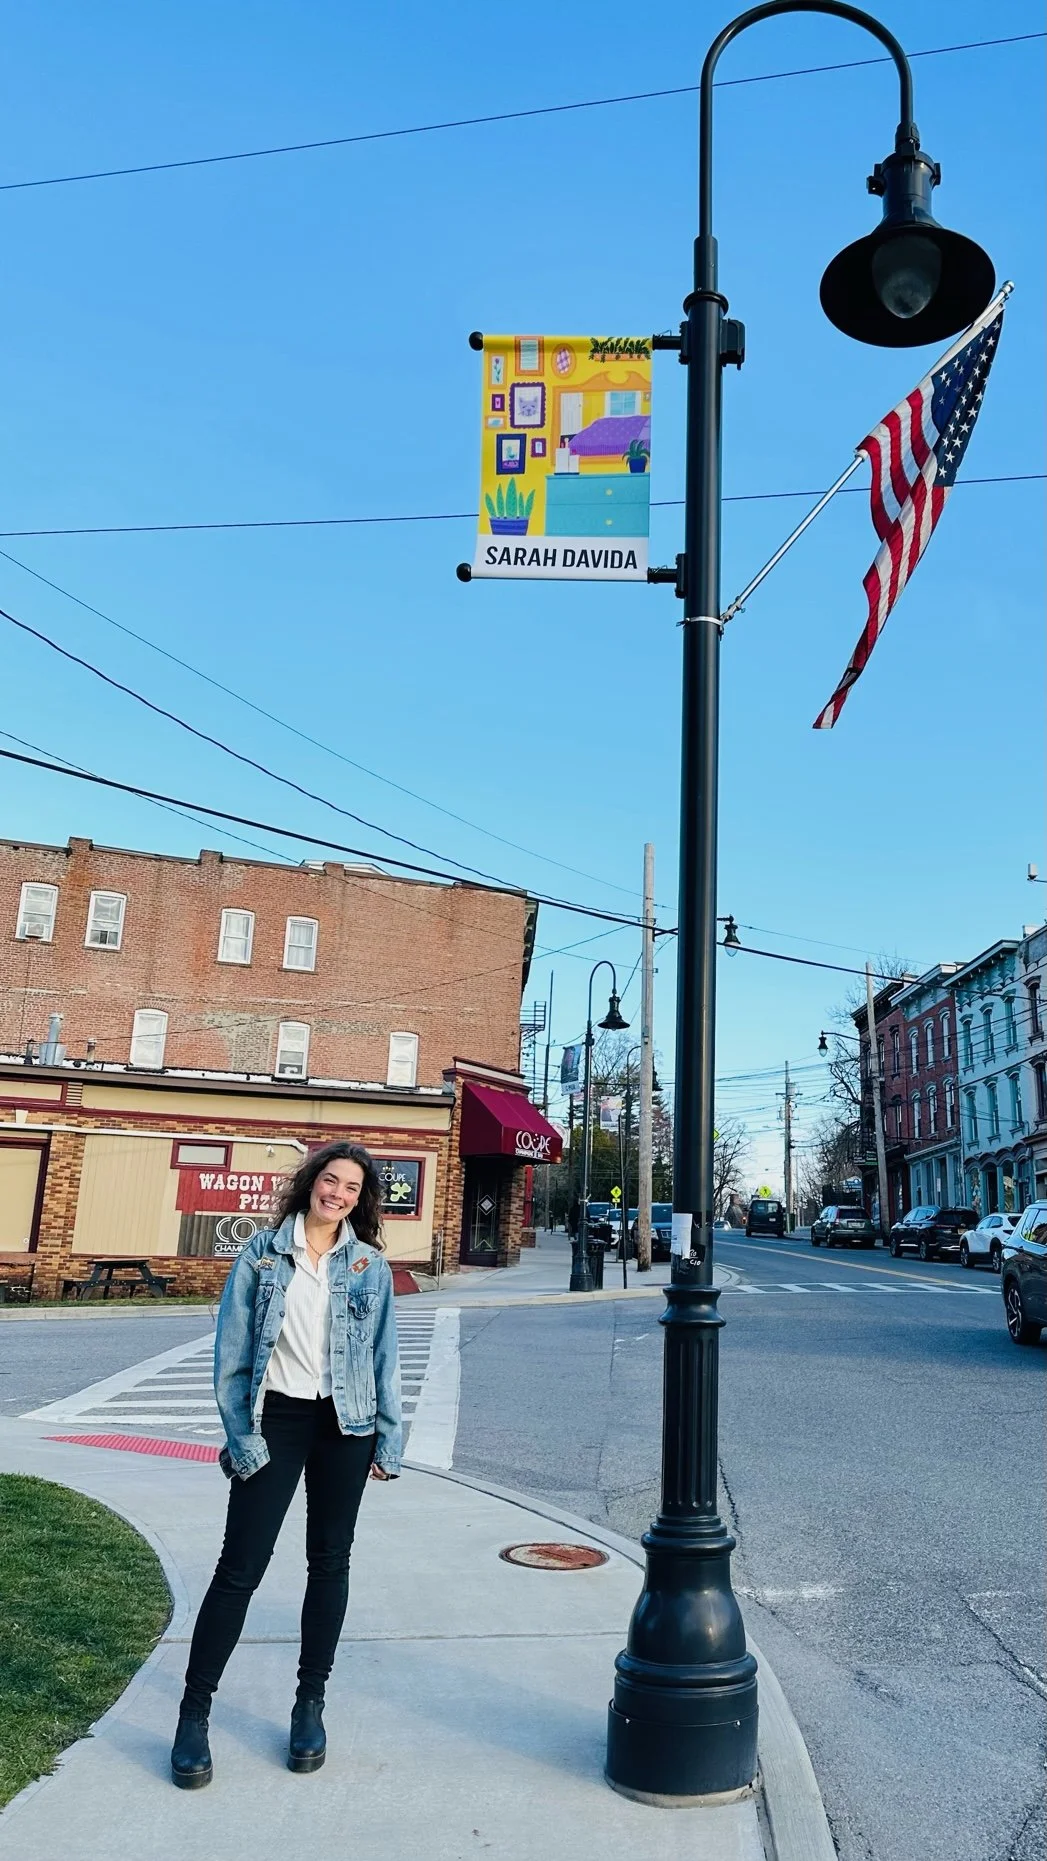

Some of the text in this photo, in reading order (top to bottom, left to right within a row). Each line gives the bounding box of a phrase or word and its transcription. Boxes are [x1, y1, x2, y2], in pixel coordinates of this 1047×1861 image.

[484, 546, 638, 570] SARAH DAVIDA
[199, 1173, 265, 1191] WAGON
[378, 1172, 406, 1182] COUPE
[239, 1193, 282, 1211] PIZZ
